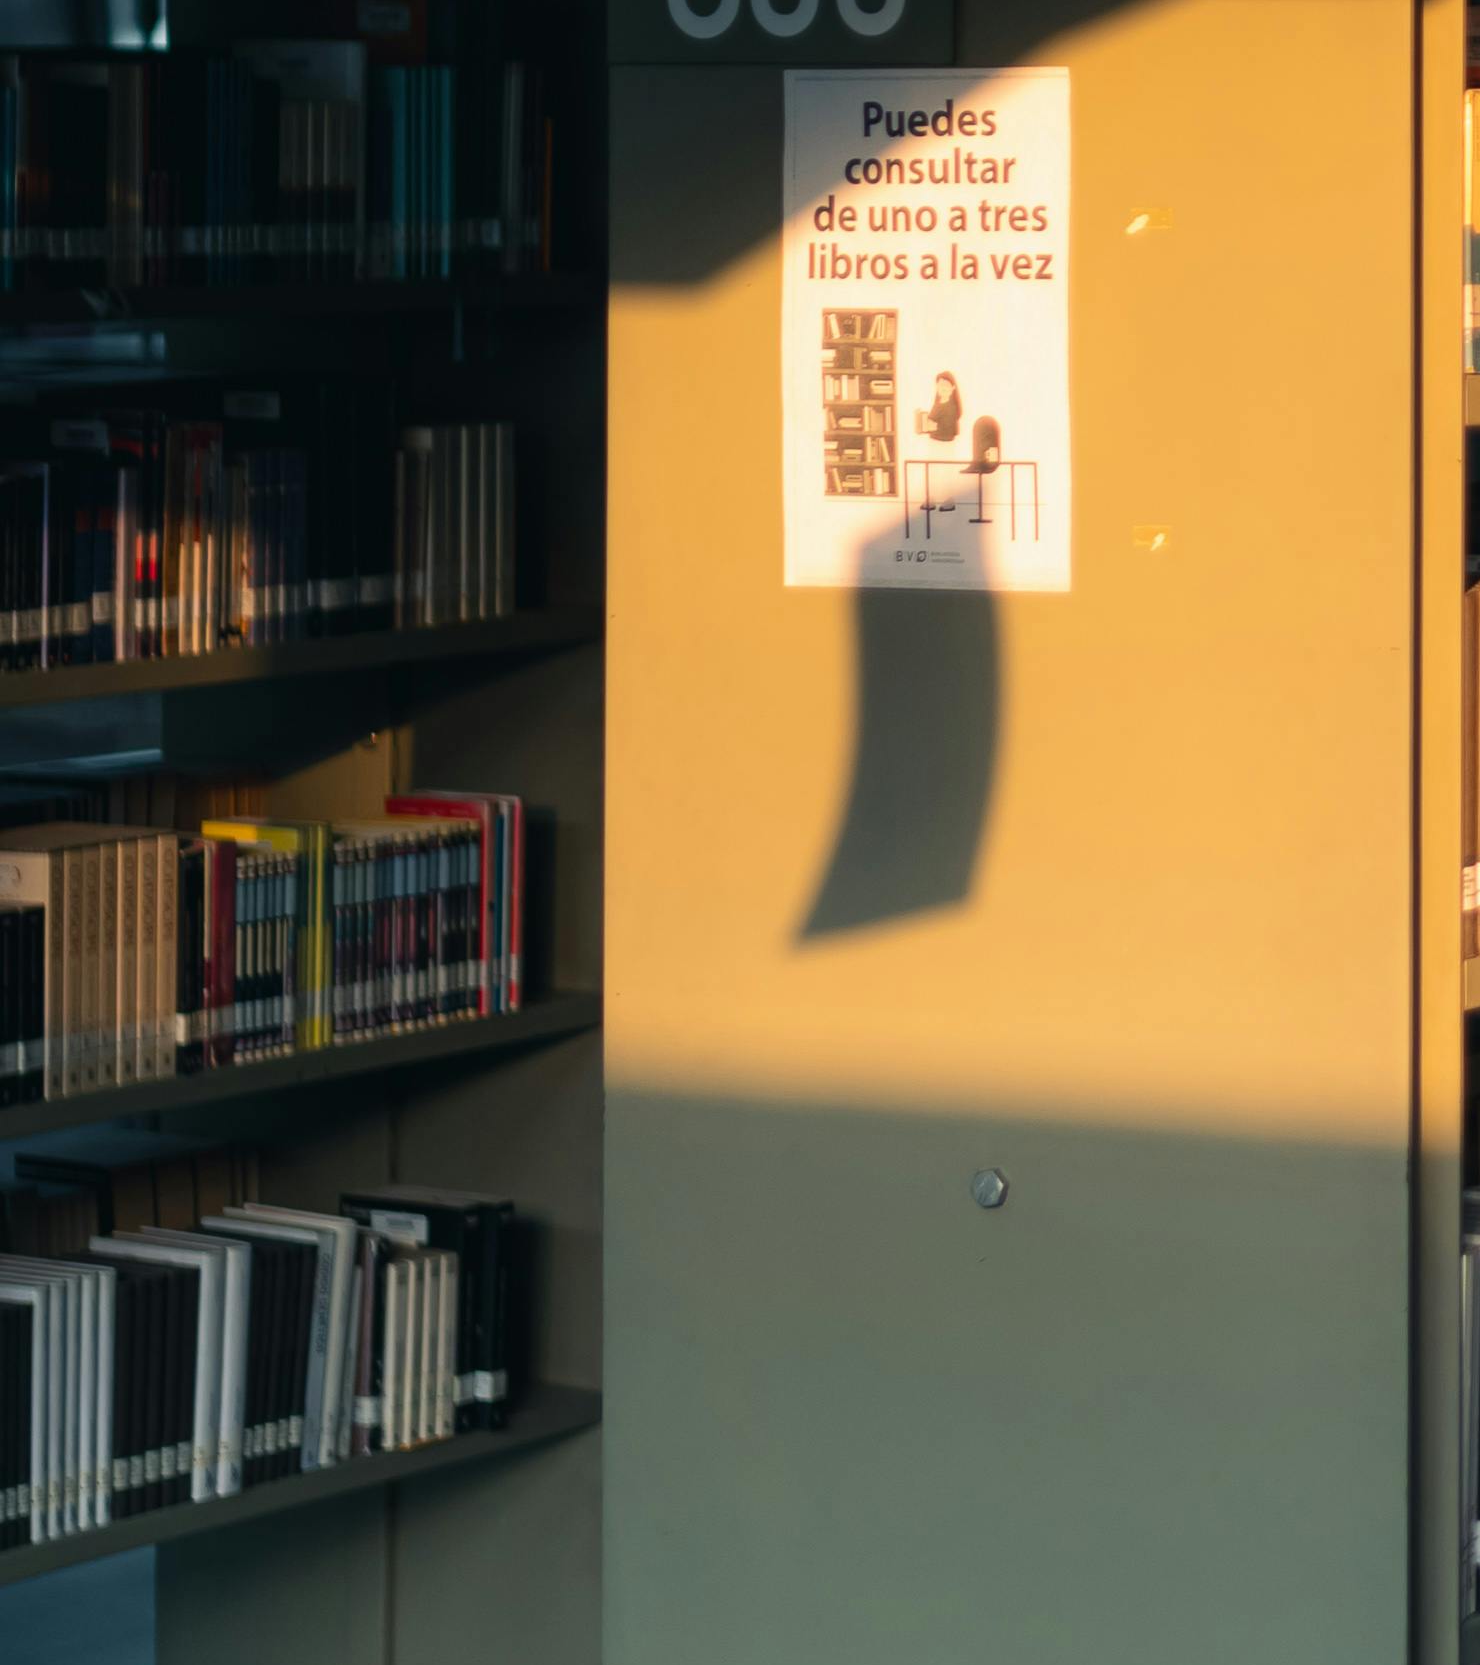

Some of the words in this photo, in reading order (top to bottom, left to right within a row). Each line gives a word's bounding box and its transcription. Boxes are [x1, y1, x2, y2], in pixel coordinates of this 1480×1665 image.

[863, 99, 997, 138] Puedes
[844, 147, 1017, 185] consultar
[813, 194, 858, 232] de
[868, 205, 938, 232] uno
[948, 205, 968, 232] a
[978, 200, 1048, 232] tres
[808, 242, 910, 280] libros
[920, 253, 939, 280] a
[950, 242, 979, 280] la
[990, 253, 1054, 280] vez
